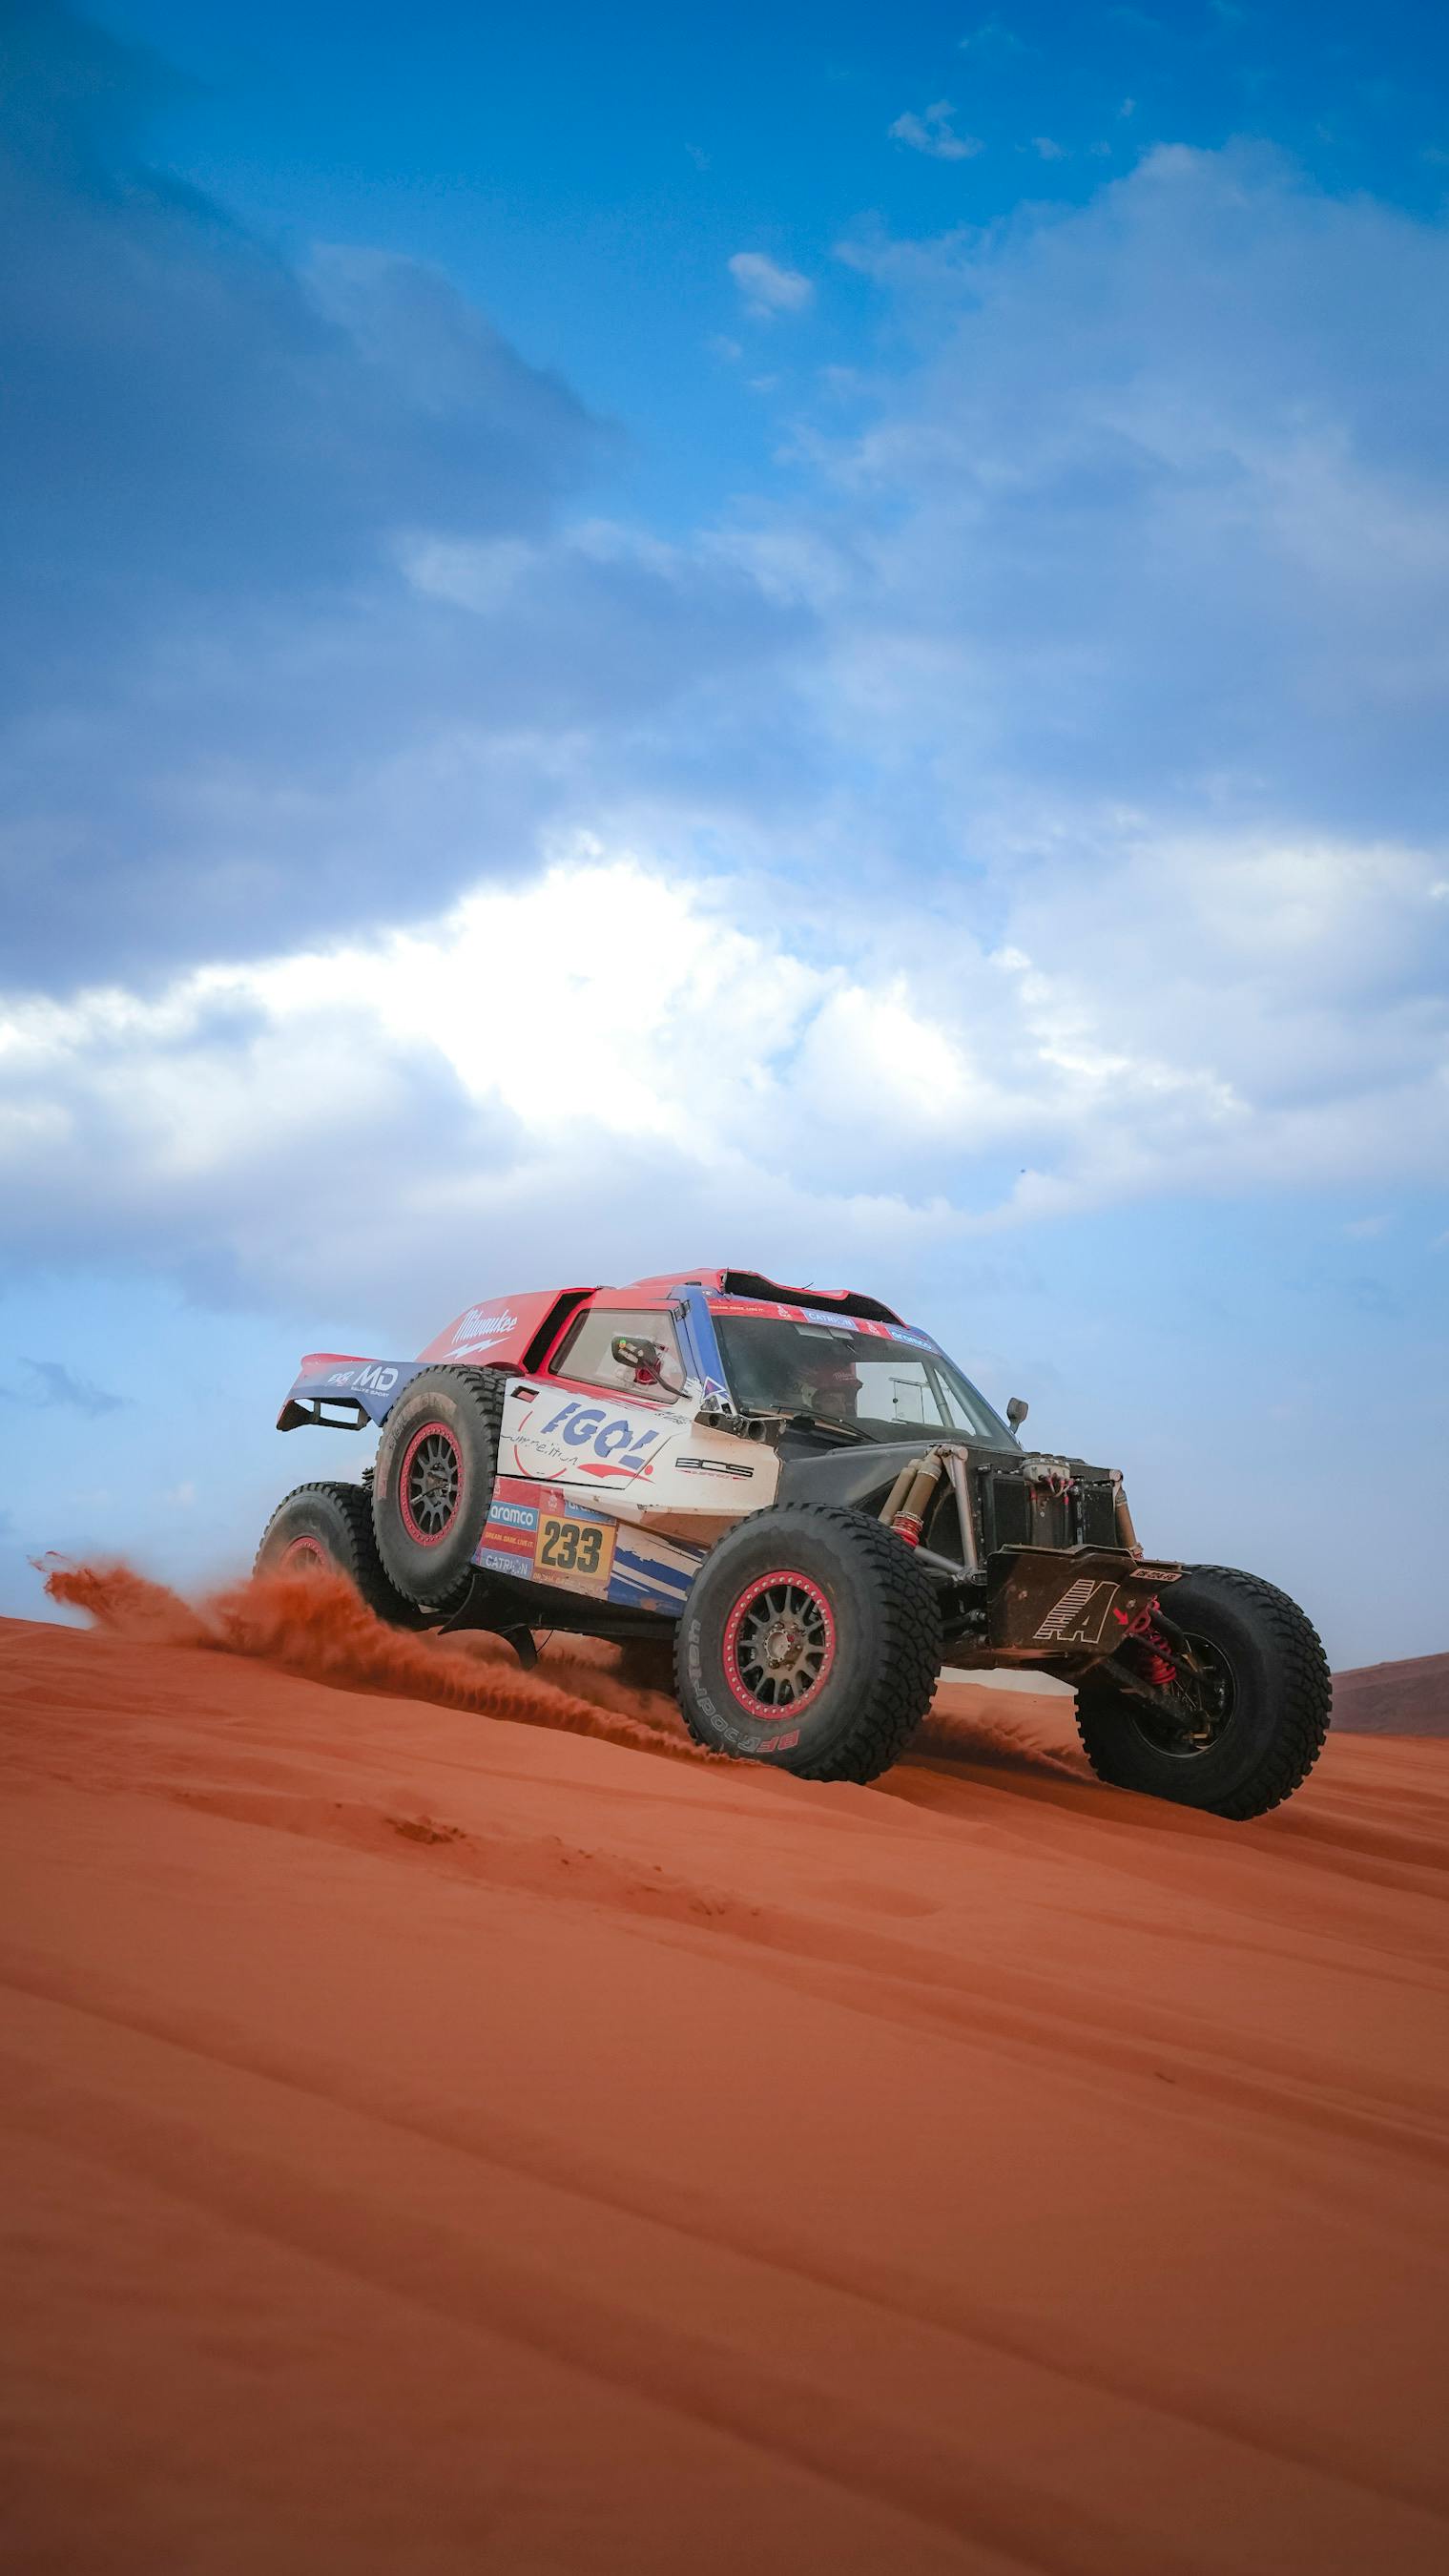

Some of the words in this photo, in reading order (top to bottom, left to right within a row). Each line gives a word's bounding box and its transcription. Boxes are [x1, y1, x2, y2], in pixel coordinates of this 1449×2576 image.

[451, 1308, 518, 1345] Milwaukee
[891, 1331, 932, 1350] aramco
[353, 1364, 399, 1391] MD
[490, 1504, 534, 1527] aramco
[541, 1520, 603, 1574] 233
